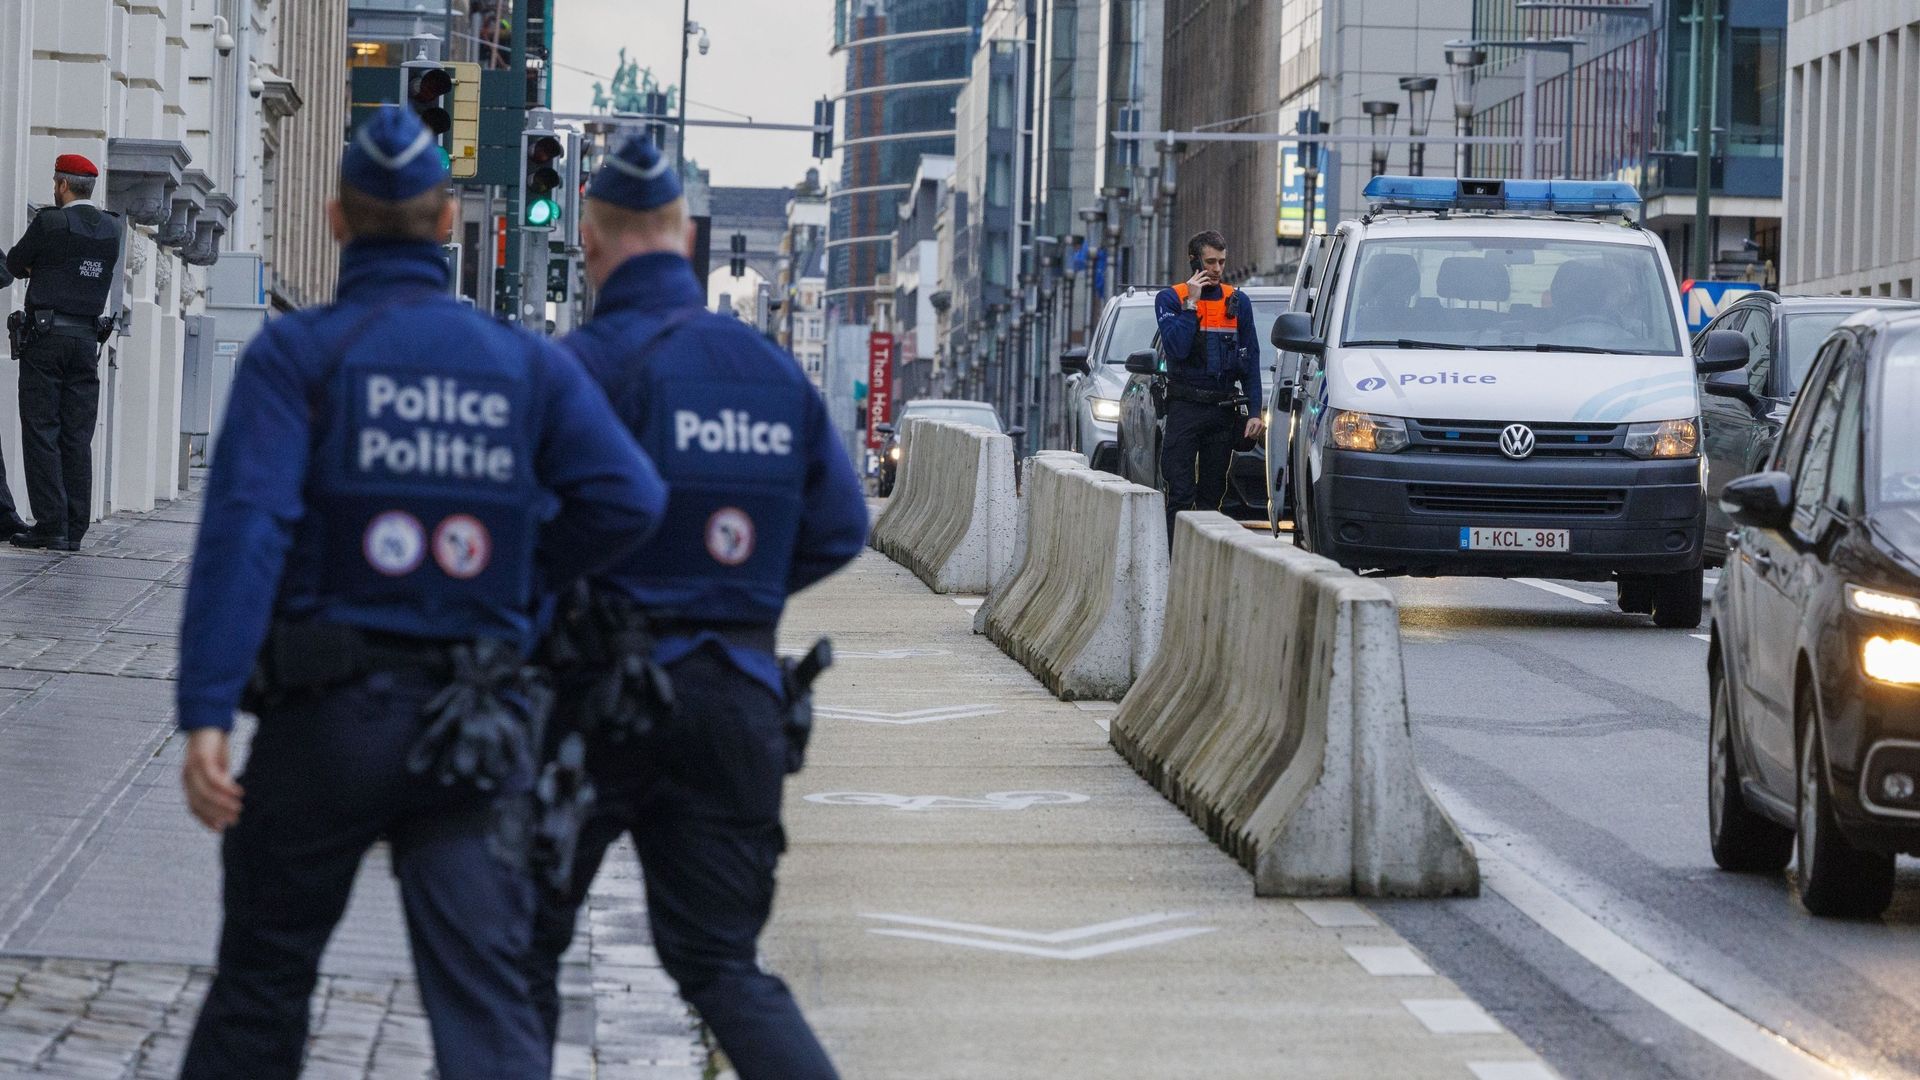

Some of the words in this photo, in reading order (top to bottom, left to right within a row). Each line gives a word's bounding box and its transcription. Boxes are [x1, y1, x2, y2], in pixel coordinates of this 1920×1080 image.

[80, 270, 100, 278] POLITIE
[83, 260, 102, 268] POLICE
[872, 348, 889, 388] Thon
[1400, 372, 1497, 386] Police
[367, 374, 511, 428] Police
[675, 409, 792, 455] Police
[359, 428, 515, 482] Politie
[1473, 530, 1565, 548] 1-KCL-981
